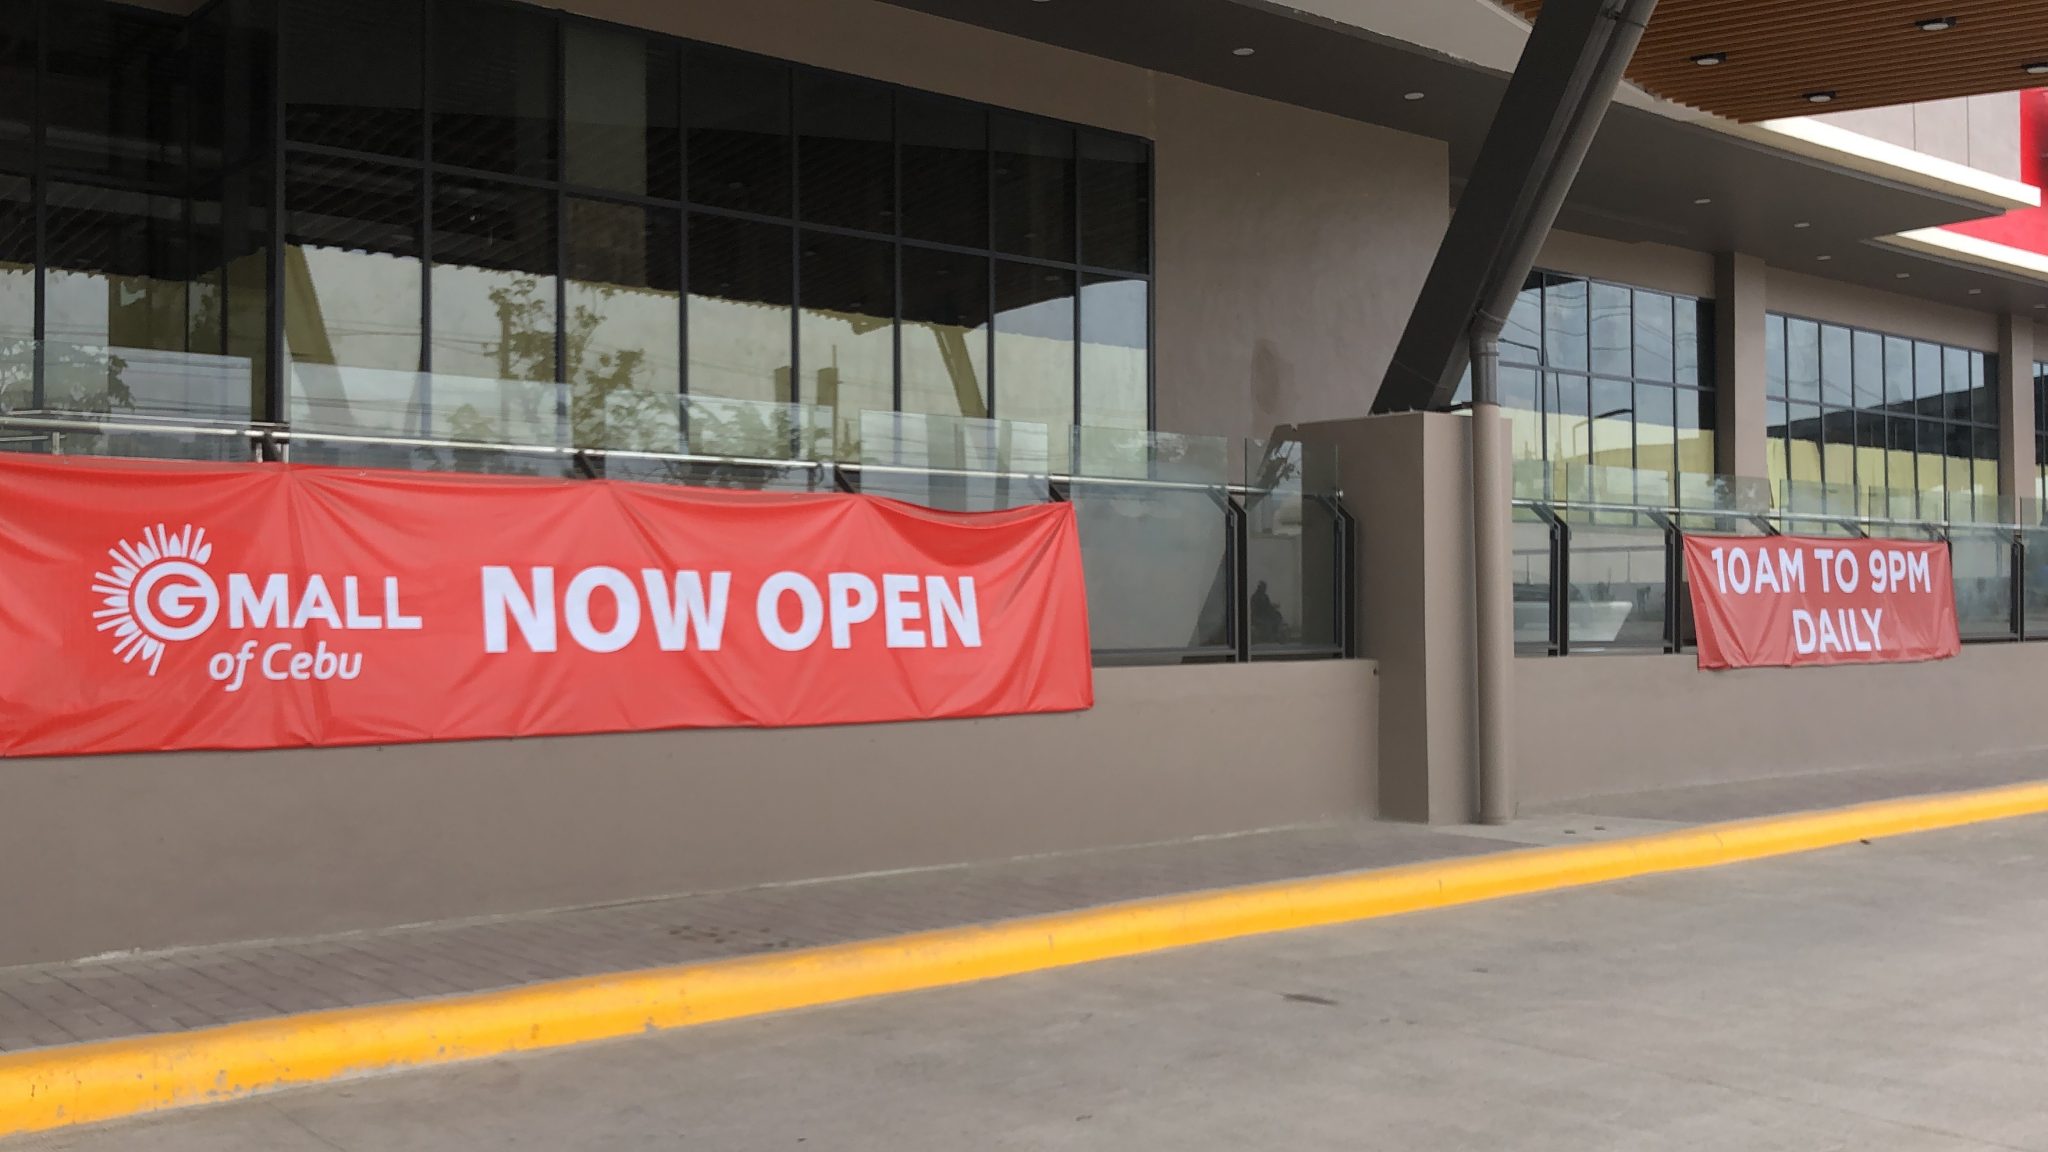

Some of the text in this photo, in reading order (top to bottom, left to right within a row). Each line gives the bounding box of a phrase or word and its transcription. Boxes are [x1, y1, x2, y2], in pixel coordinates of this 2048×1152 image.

[1711, 546, 1931, 595] 10AM TO 9PM
[481, 565, 982, 653] NOW OPEN
[1792, 607, 1883, 655] DAILY
[209, 640, 363, 692] of Cebu
